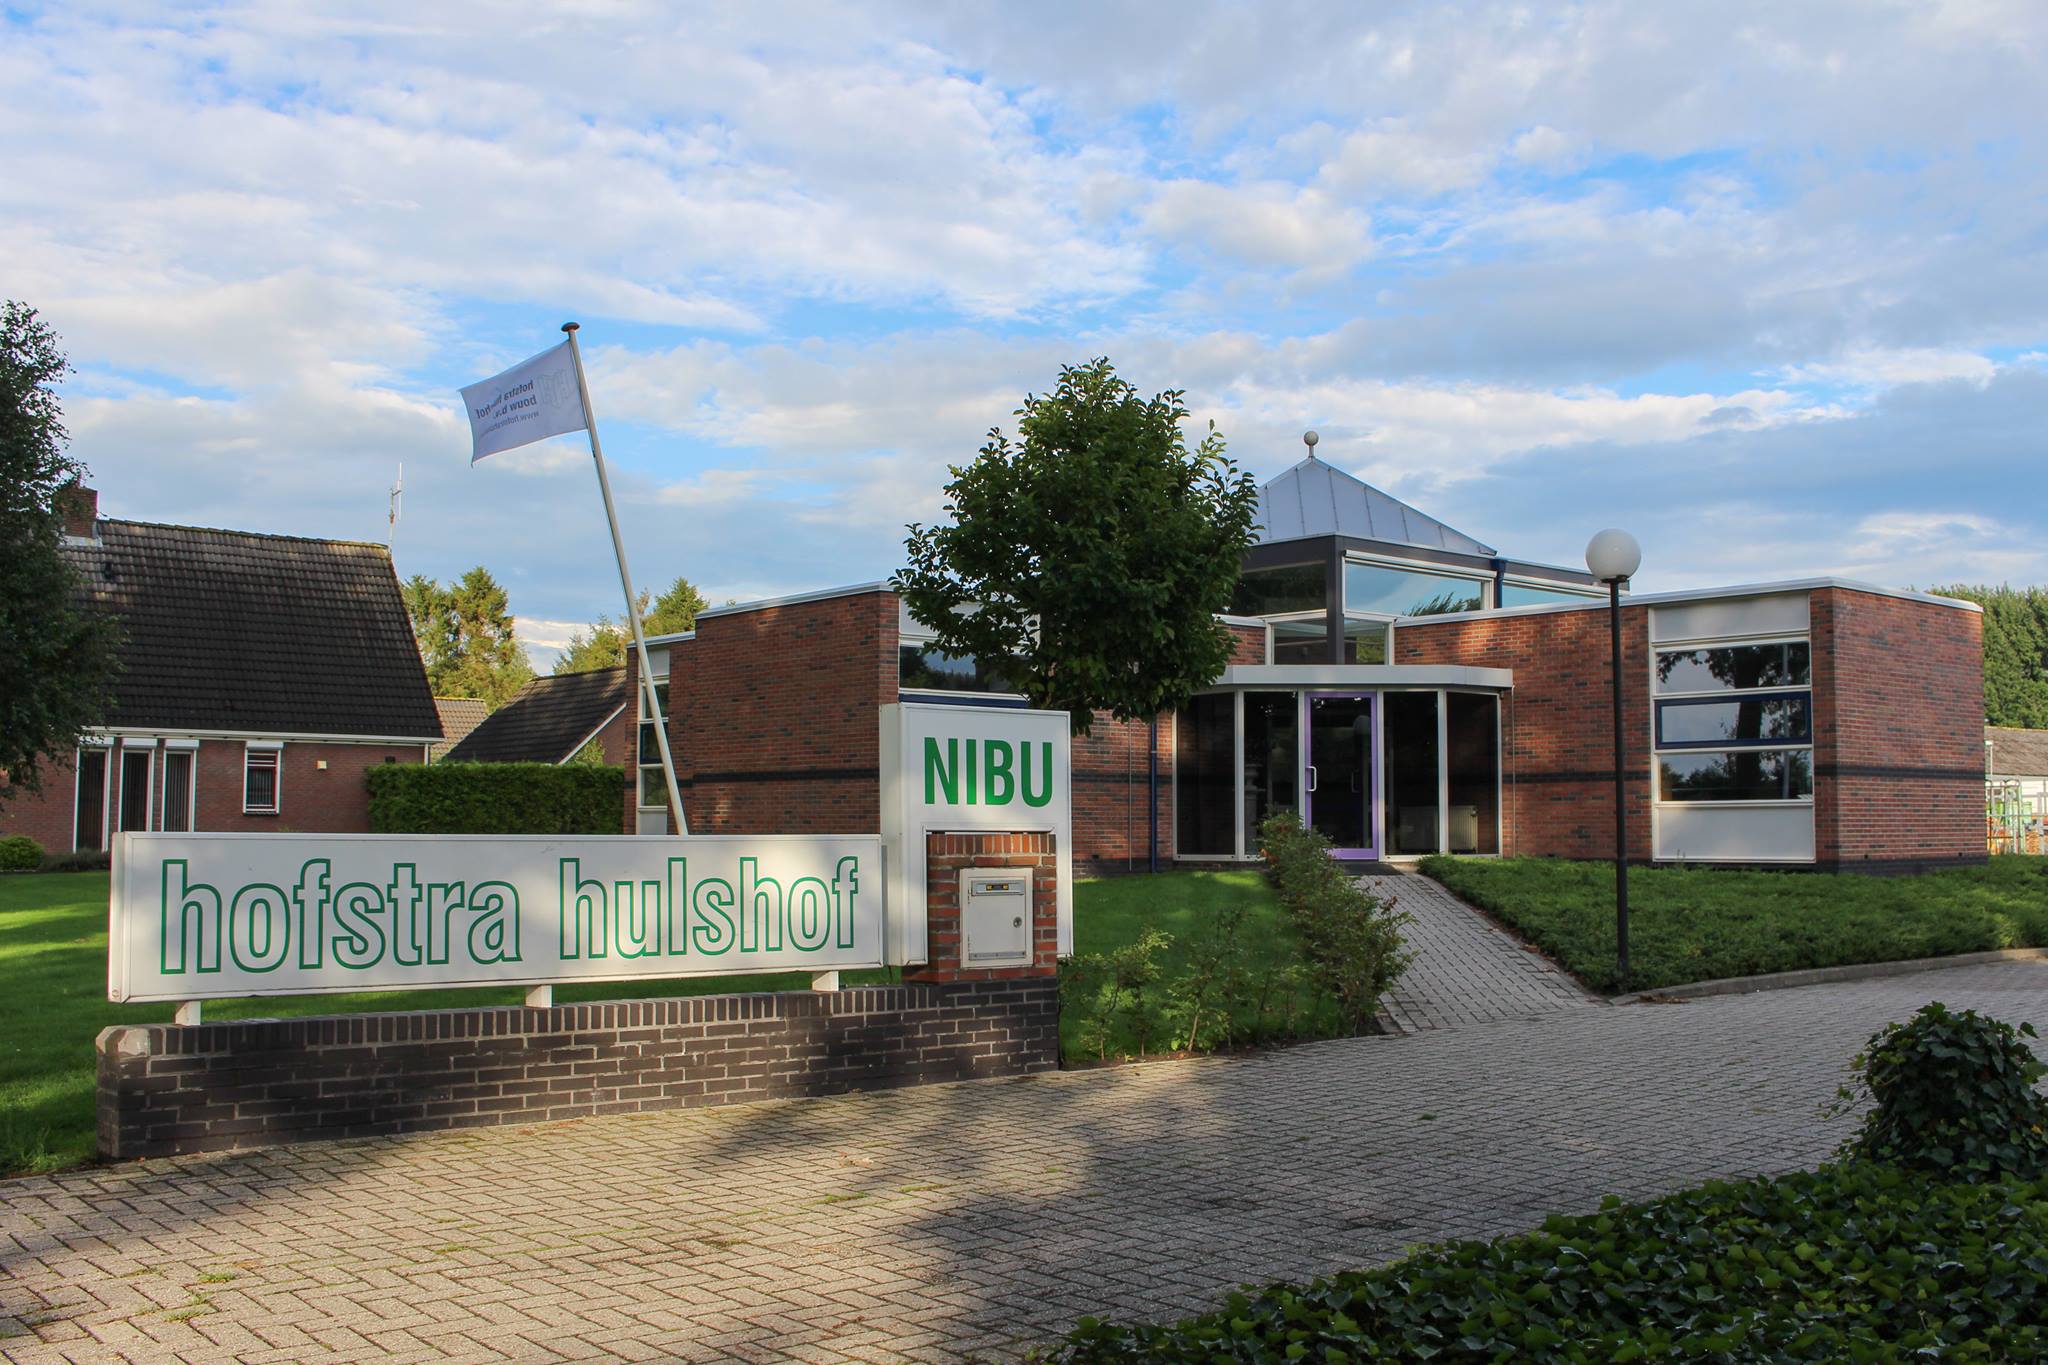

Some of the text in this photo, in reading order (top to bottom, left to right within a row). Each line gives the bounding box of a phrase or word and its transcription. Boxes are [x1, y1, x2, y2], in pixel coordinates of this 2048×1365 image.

[924, 737, 1053, 807] NIBU
[160, 856, 858, 975] hofstra hulshof
